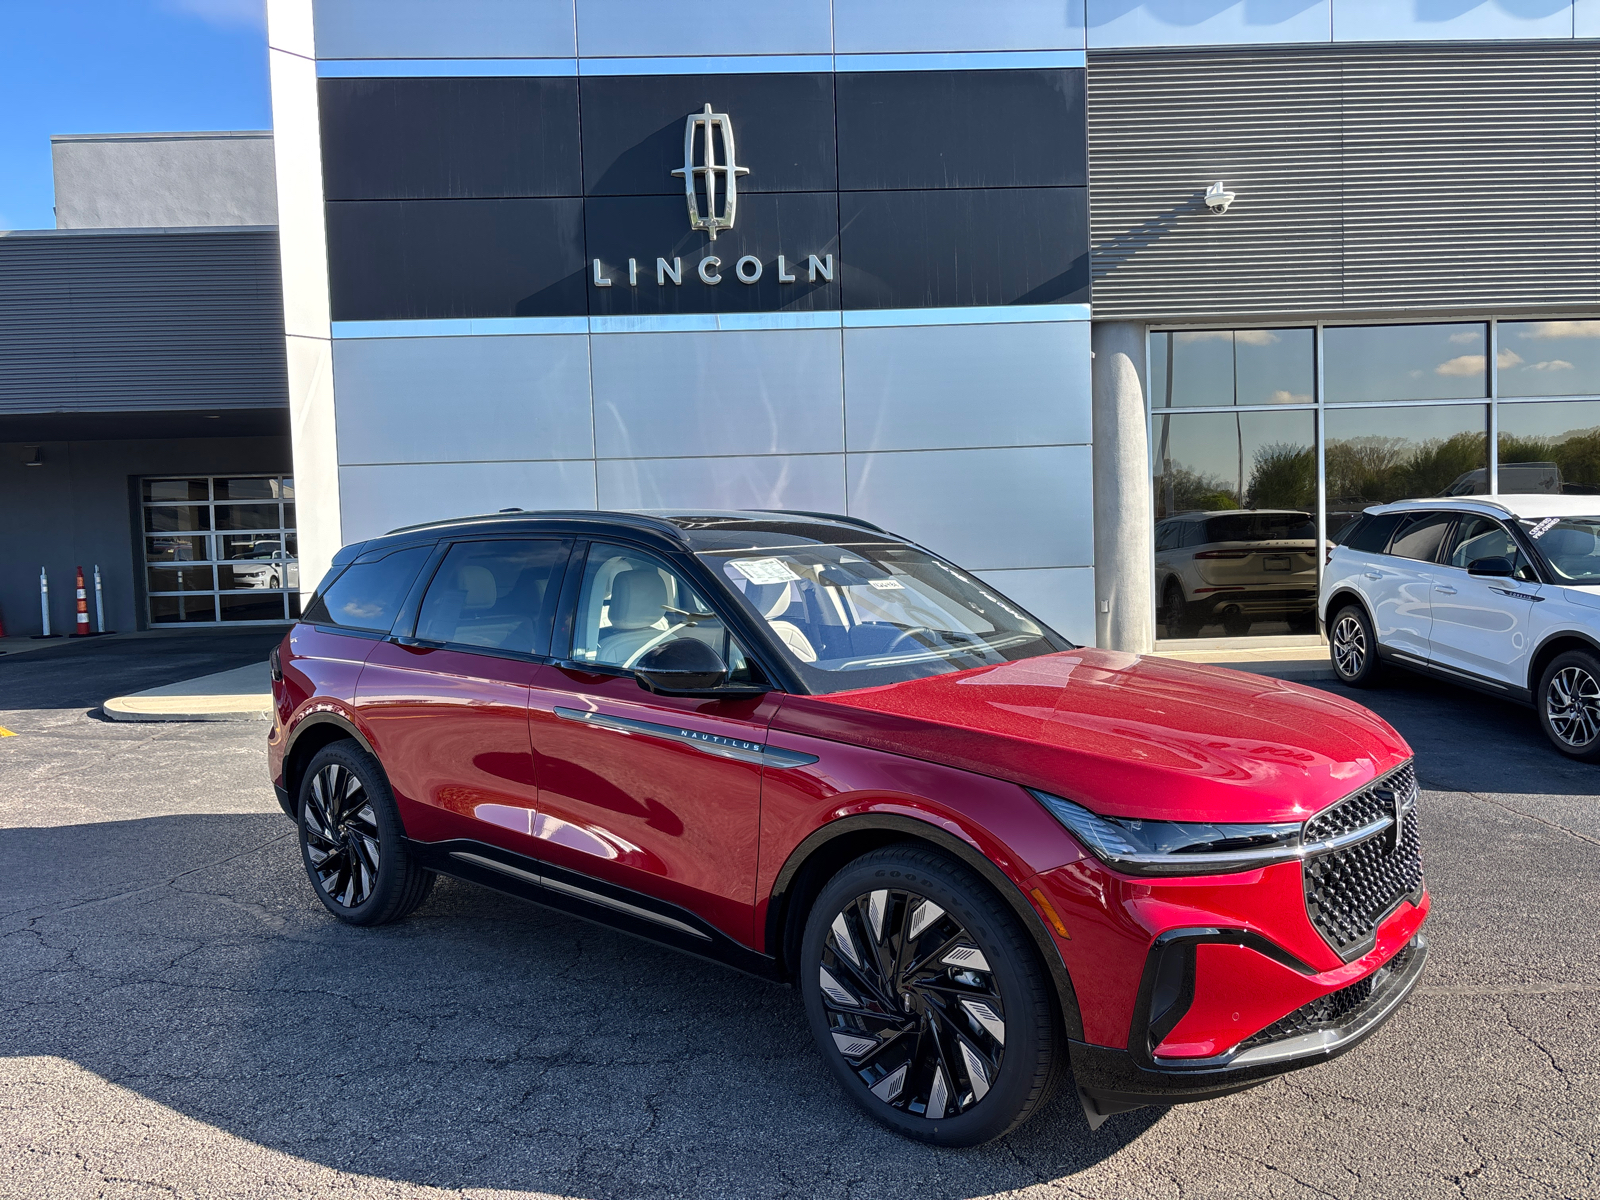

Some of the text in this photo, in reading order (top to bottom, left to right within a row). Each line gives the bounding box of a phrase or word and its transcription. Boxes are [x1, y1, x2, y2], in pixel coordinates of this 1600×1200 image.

[593, 254, 834, 286] LINCOLN
[680, 730, 760, 752] NAUTILUS
[874, 869, 1001, 958] GOODYEAR
